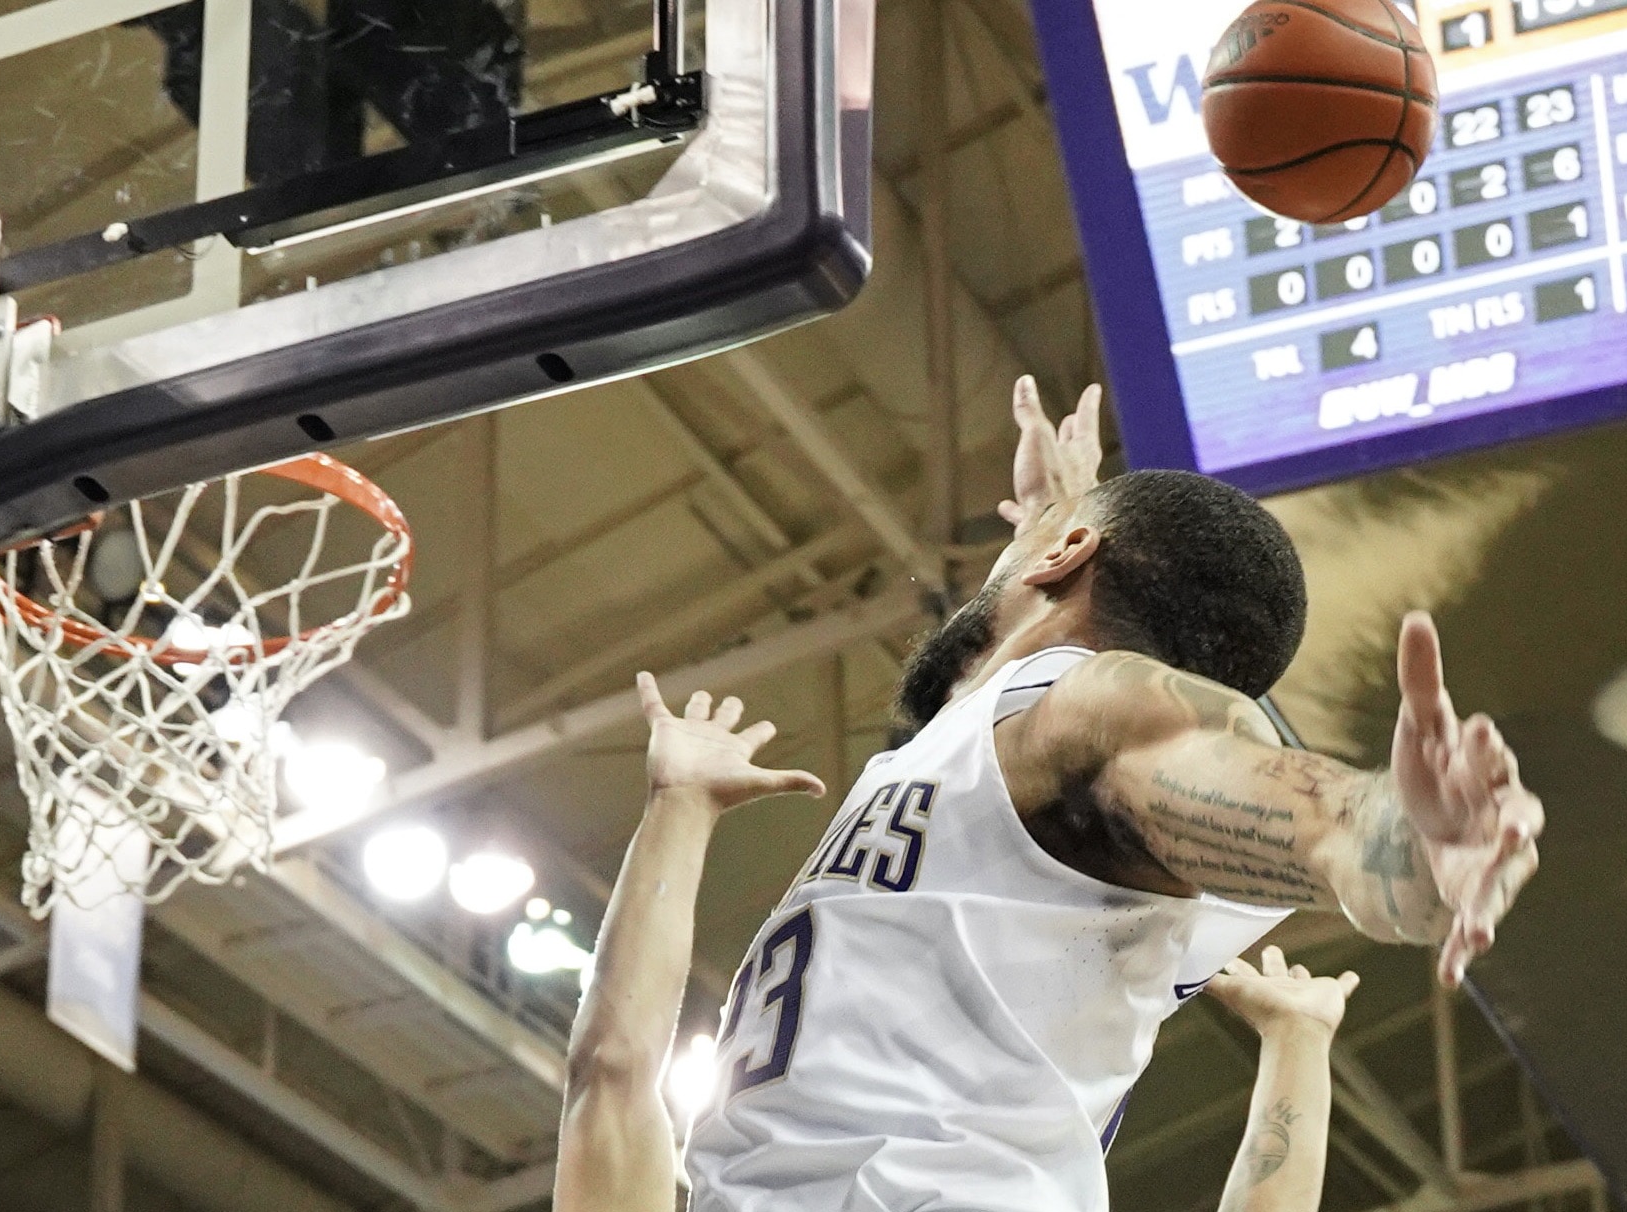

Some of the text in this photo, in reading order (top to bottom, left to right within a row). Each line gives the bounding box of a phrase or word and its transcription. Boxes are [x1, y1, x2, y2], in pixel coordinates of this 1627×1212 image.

[1452, 107, 1500, 146] 22
[1409, 181, 1436, 214] 0
[1481, 164, 1507, 199] 2
[1277, 271, 1306, 305] 0
[1345, 255, 1373, 290] 0
[1412, 240, 1441, 274] 0
[1485, 223, 1513, 257] 0
[1568, 206, 1588, 238] 1
[1350, 327, 1377, 359] 4
[1575, 277, 1595, 311] 1
